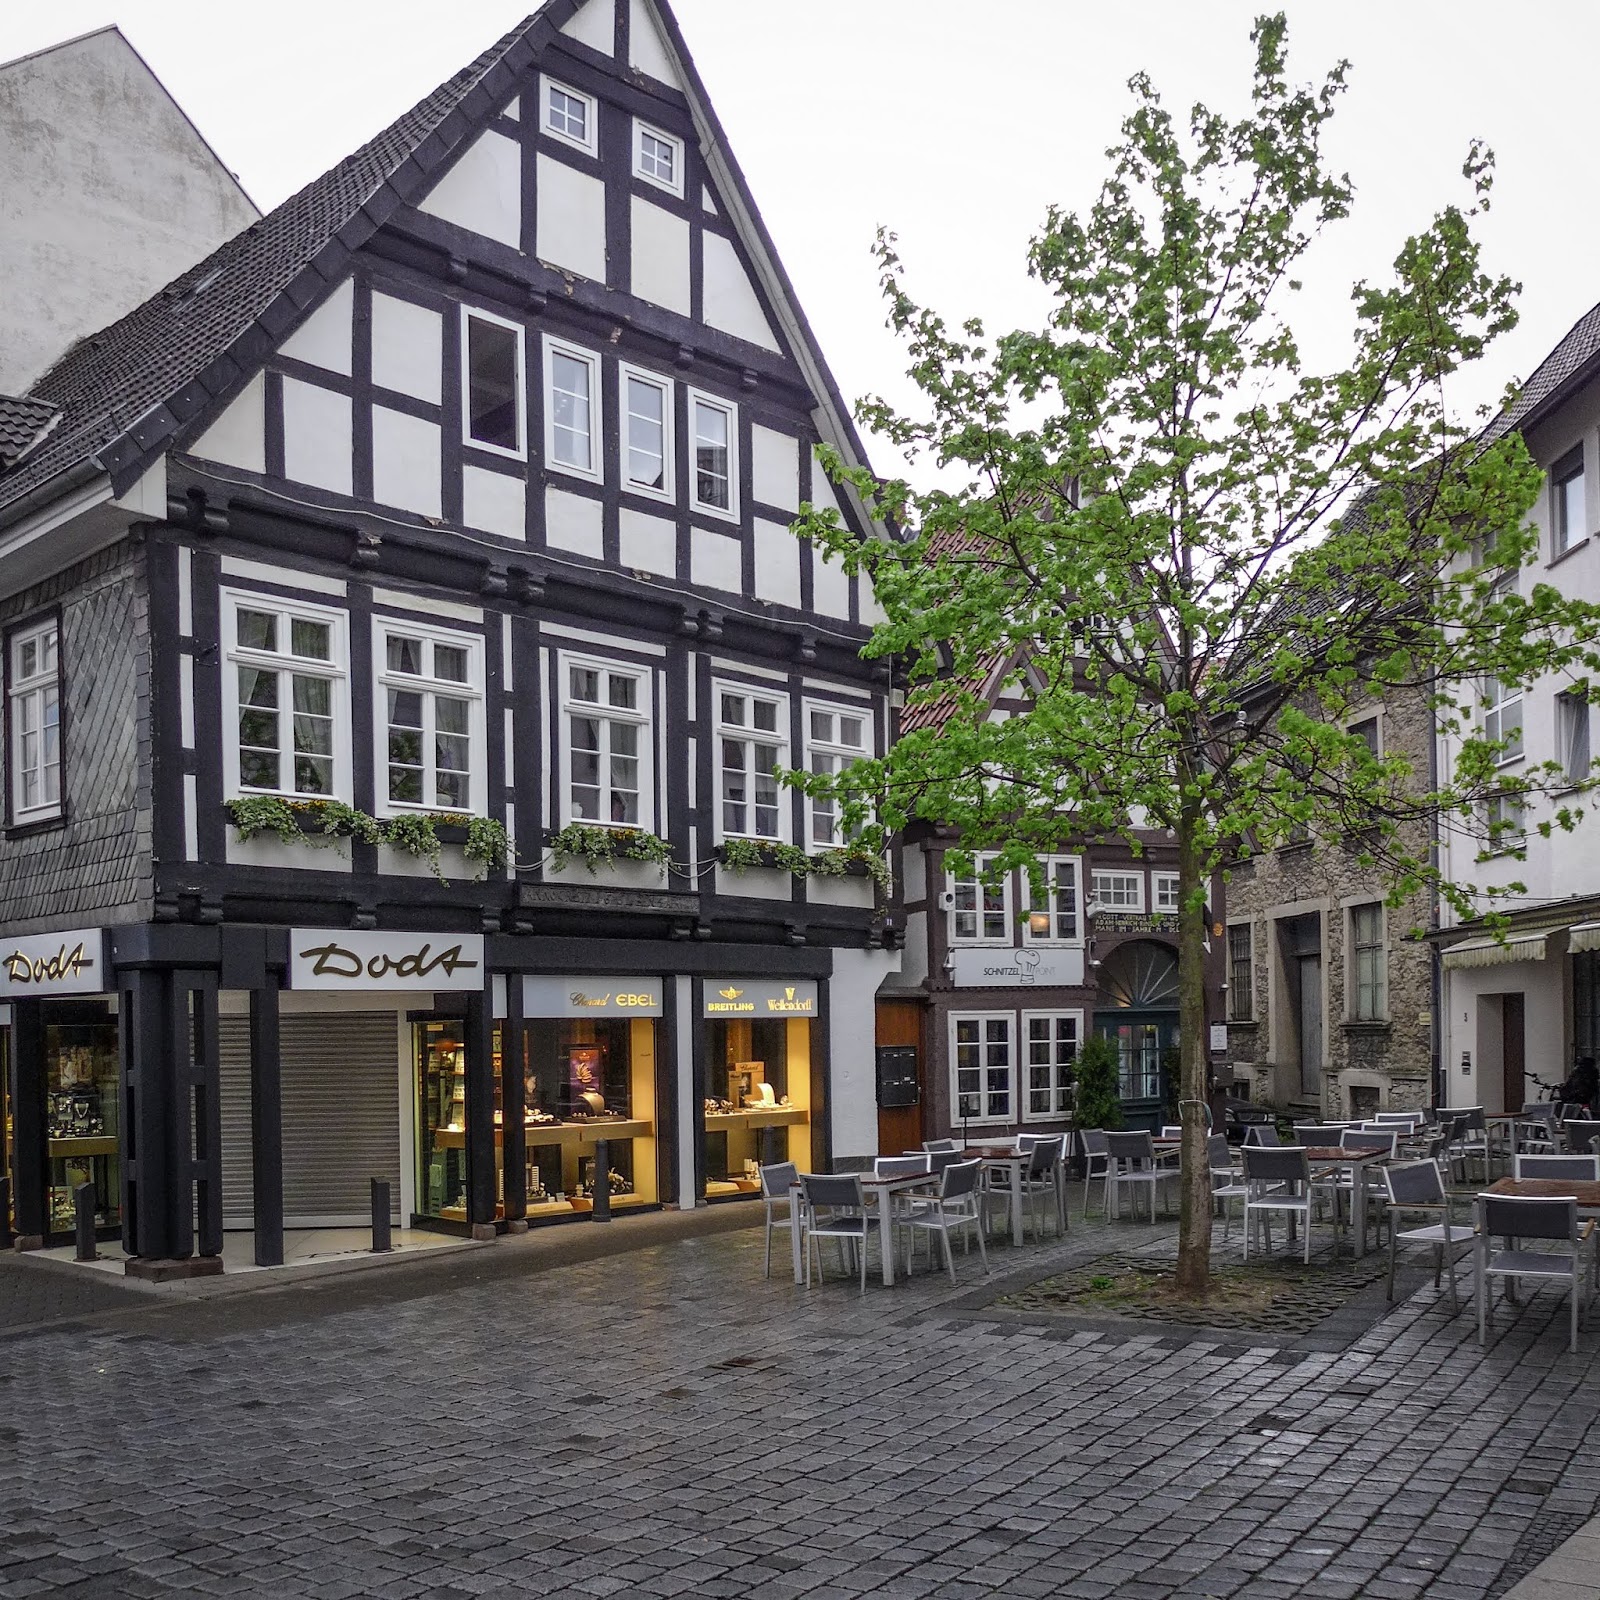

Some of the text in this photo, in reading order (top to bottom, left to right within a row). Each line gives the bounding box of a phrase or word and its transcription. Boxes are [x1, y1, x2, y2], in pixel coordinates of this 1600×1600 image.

[983, 967, 1020, 976] SCHNITZEL
[615, 993, 658, 1007] EBEL
[707, 1002, 755, 1012] BREITLING
